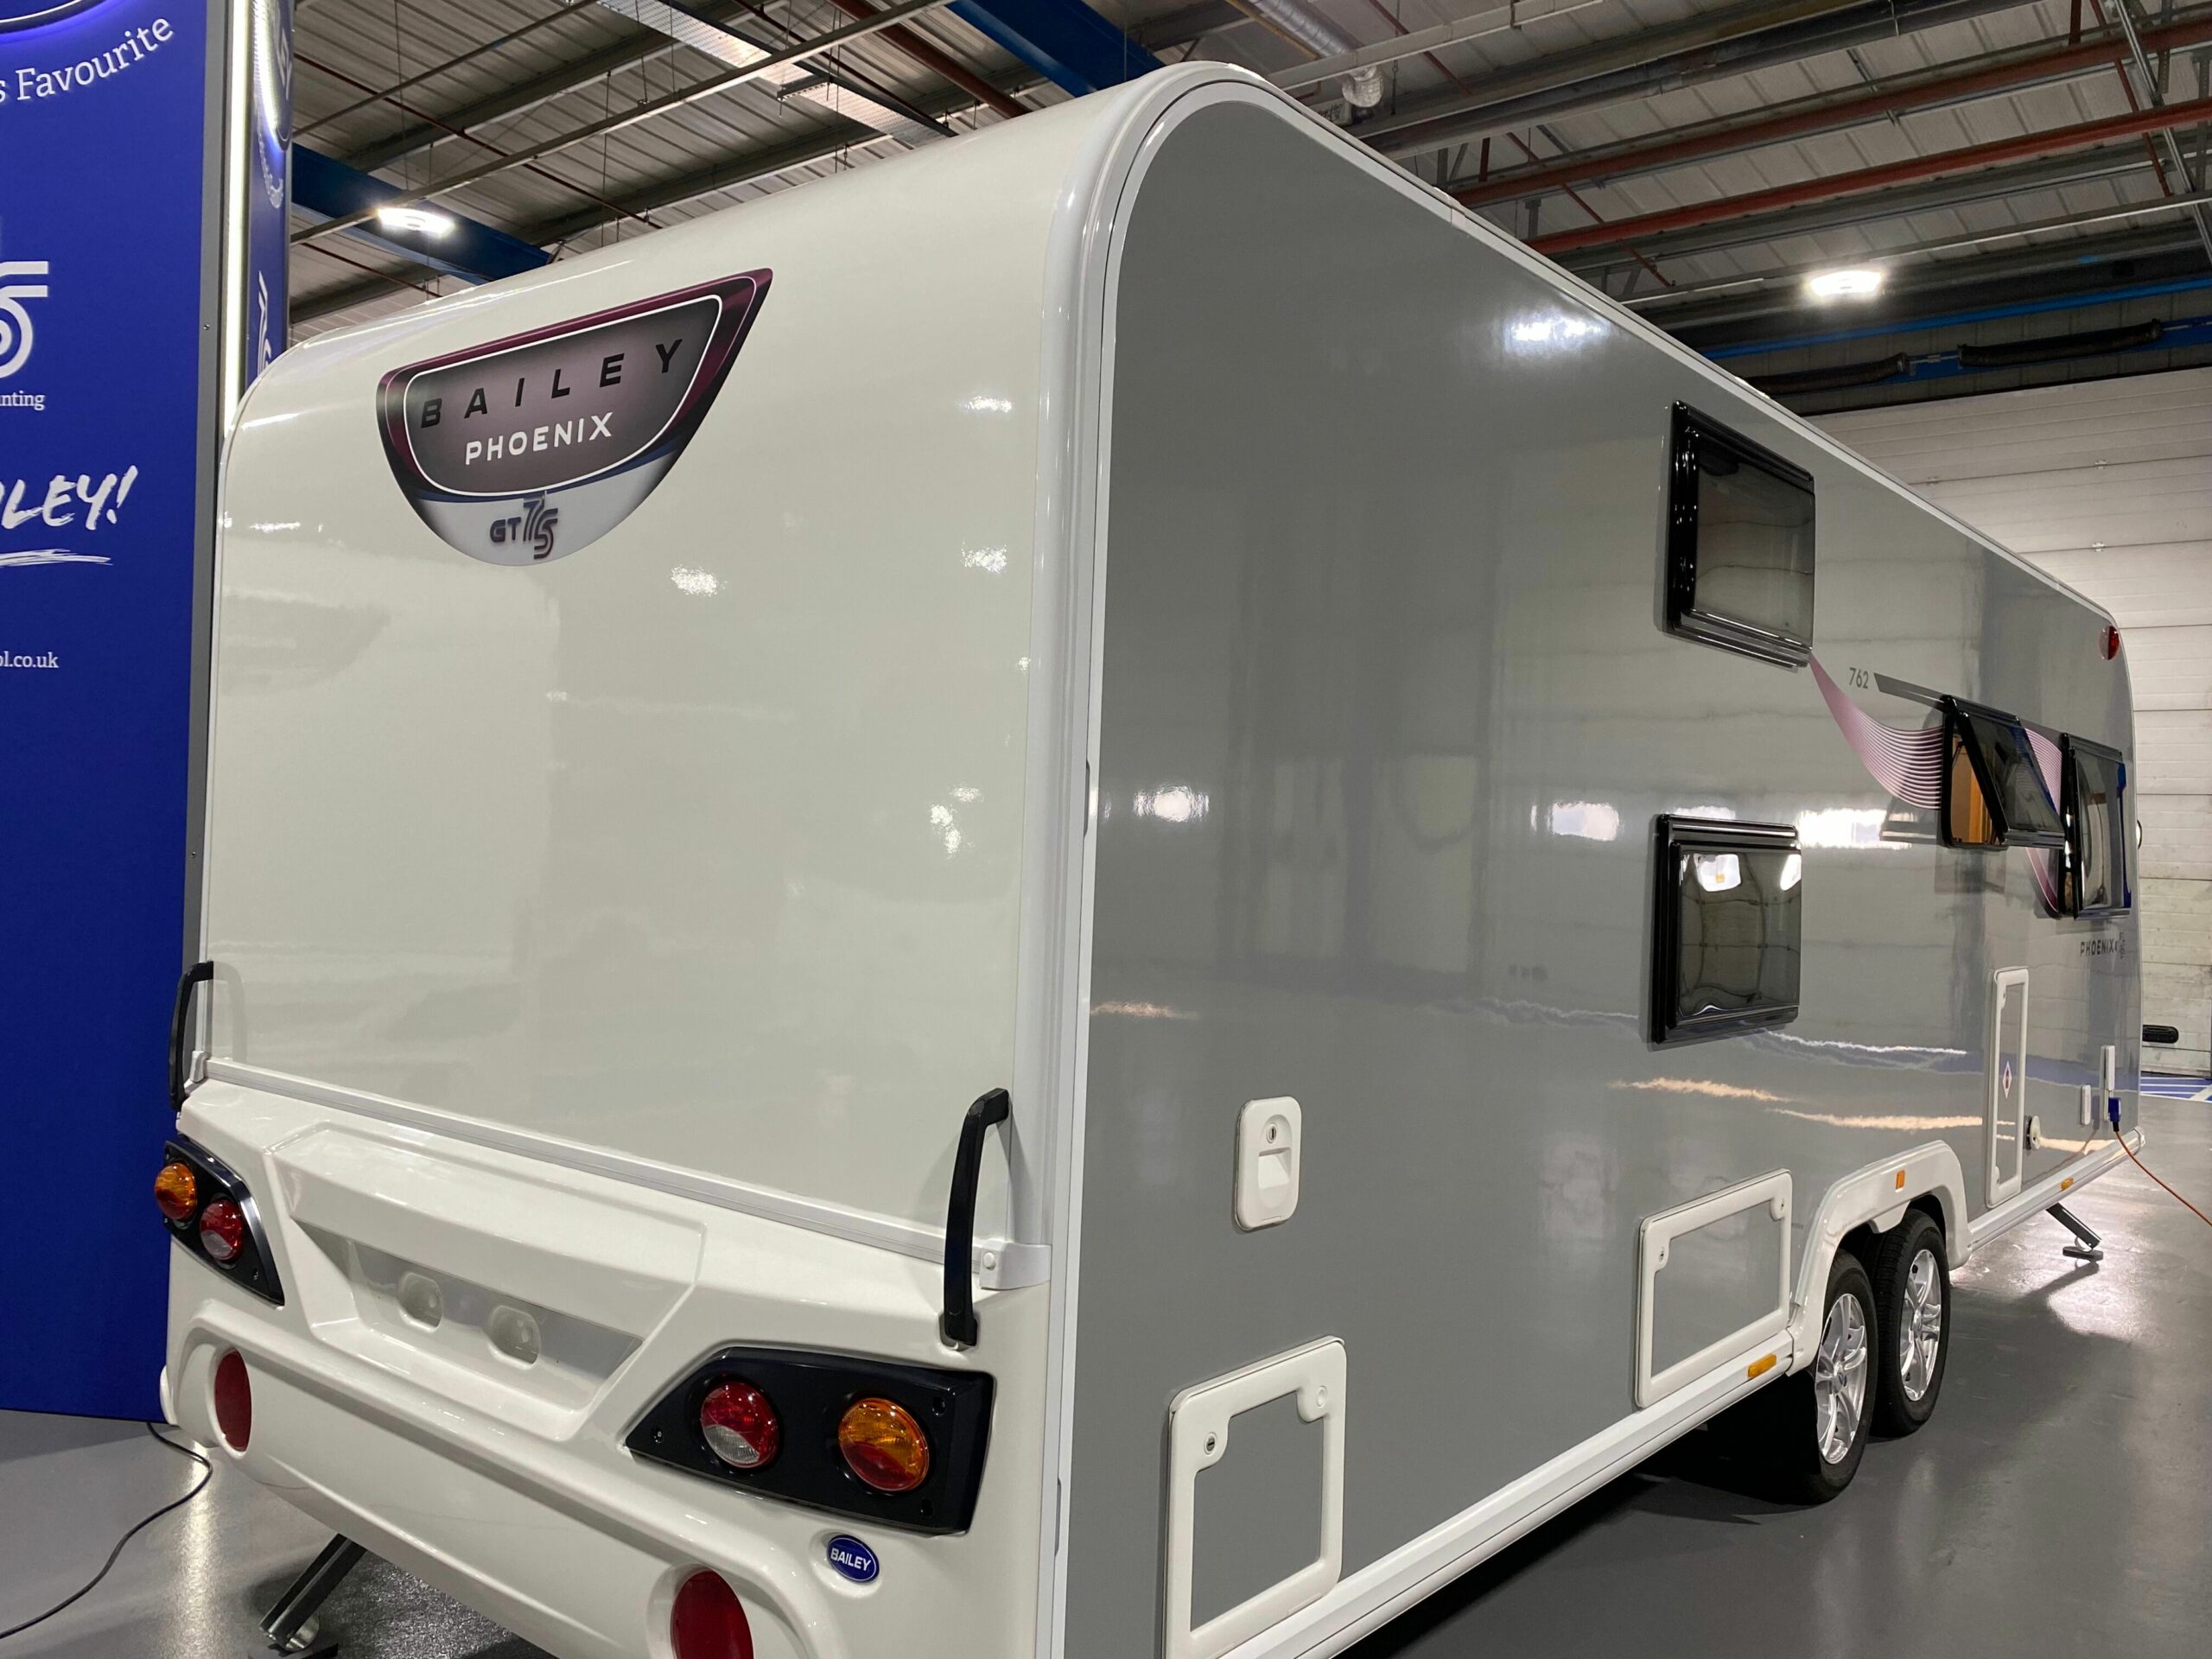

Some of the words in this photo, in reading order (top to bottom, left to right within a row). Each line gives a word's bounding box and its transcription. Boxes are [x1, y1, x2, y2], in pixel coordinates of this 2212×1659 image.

[16, 17, 174, 100] Favourite
[421, 339, 683, 429] BAILEY
[465, 412, 613, 465] PHOENIX
[0, 465, 138, 531] LEY!
[1849, 667, 1869, 690] 762
[2080, 938, 2113, 957] PHOENIX
[830, 1548, 871, 1571] BAILEY
